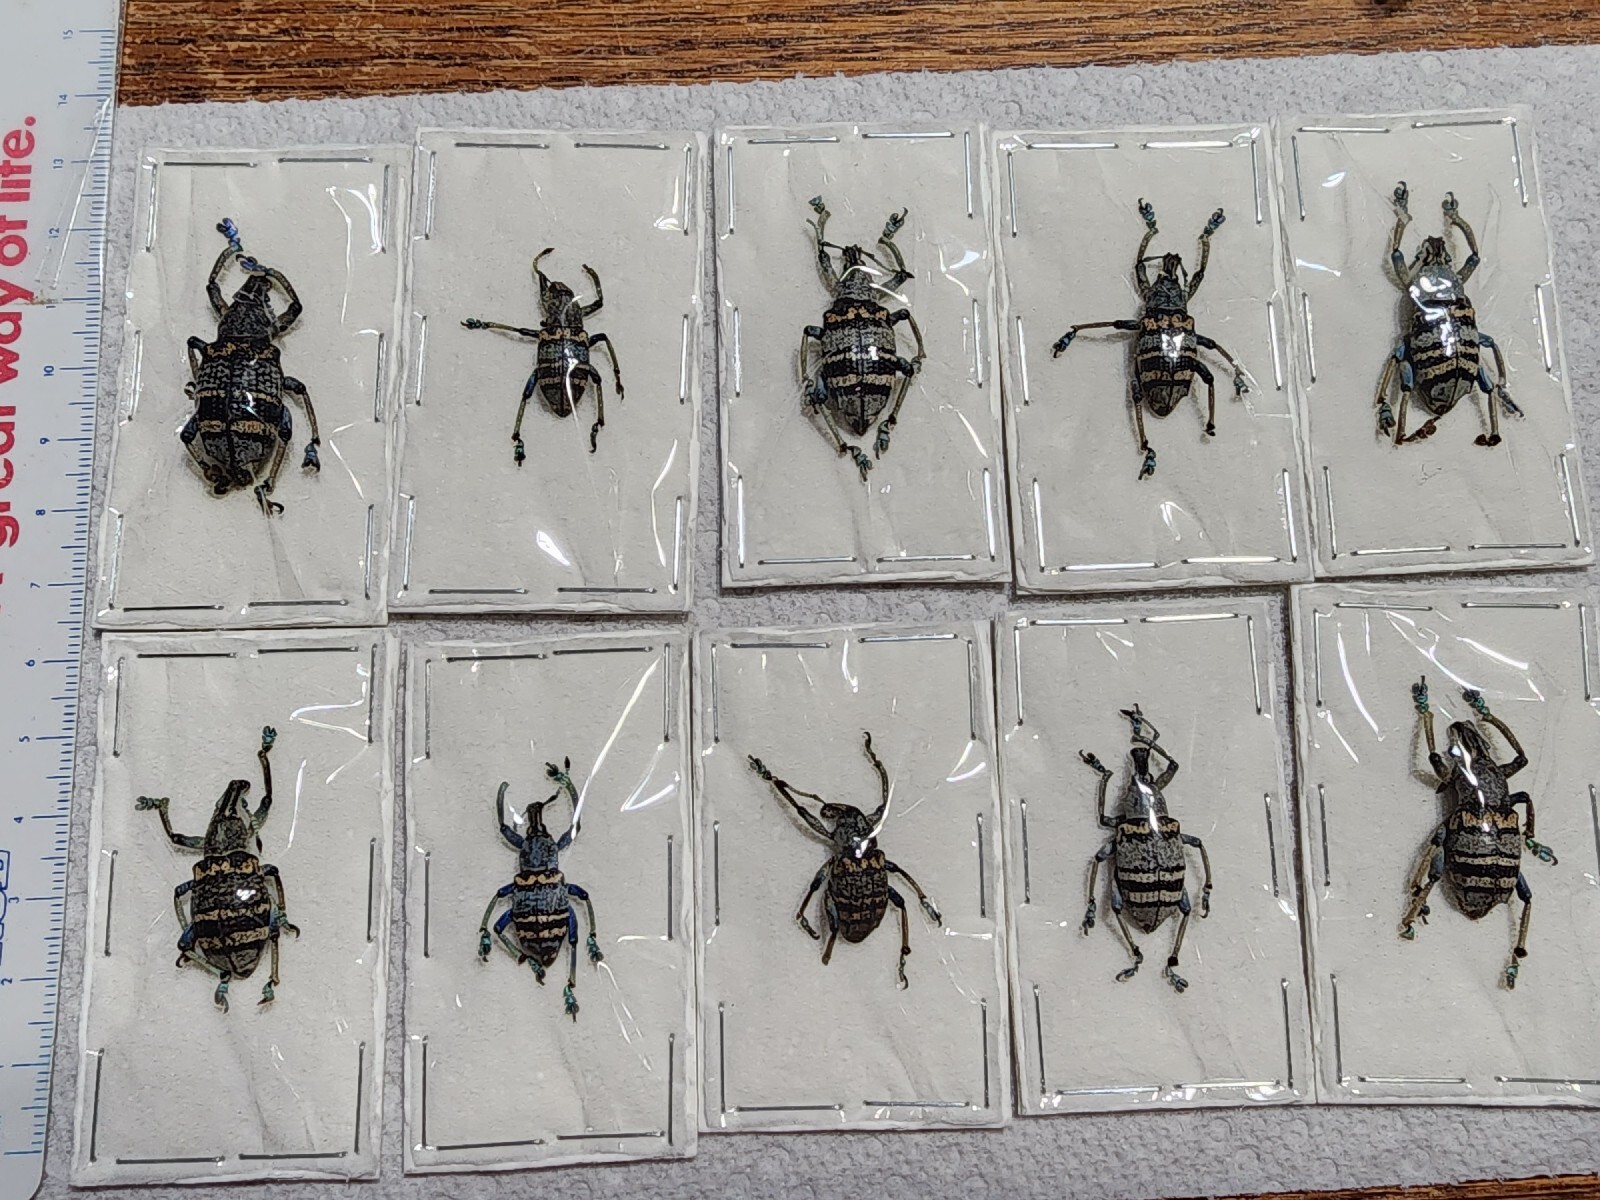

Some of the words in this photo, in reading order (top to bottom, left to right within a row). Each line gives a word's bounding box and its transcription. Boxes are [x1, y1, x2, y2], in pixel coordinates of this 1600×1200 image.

[63, 29, 74, 40] 15
[58, 94, 69, 106] 14
[0, 116, 37, 203] life.
[53, 158, 65, 170] 13
[49, 227, 60, 239] 12
[0, 215, 28, 266] of
[44, 365, 55, 377] 10
[40, 437, 50, 445] 9
[25, 659, 36, 667] 6
[14, 816, 24, 824] 4
[8, 896, 20, 904] 3
[1, 977, 13, 986] 2
